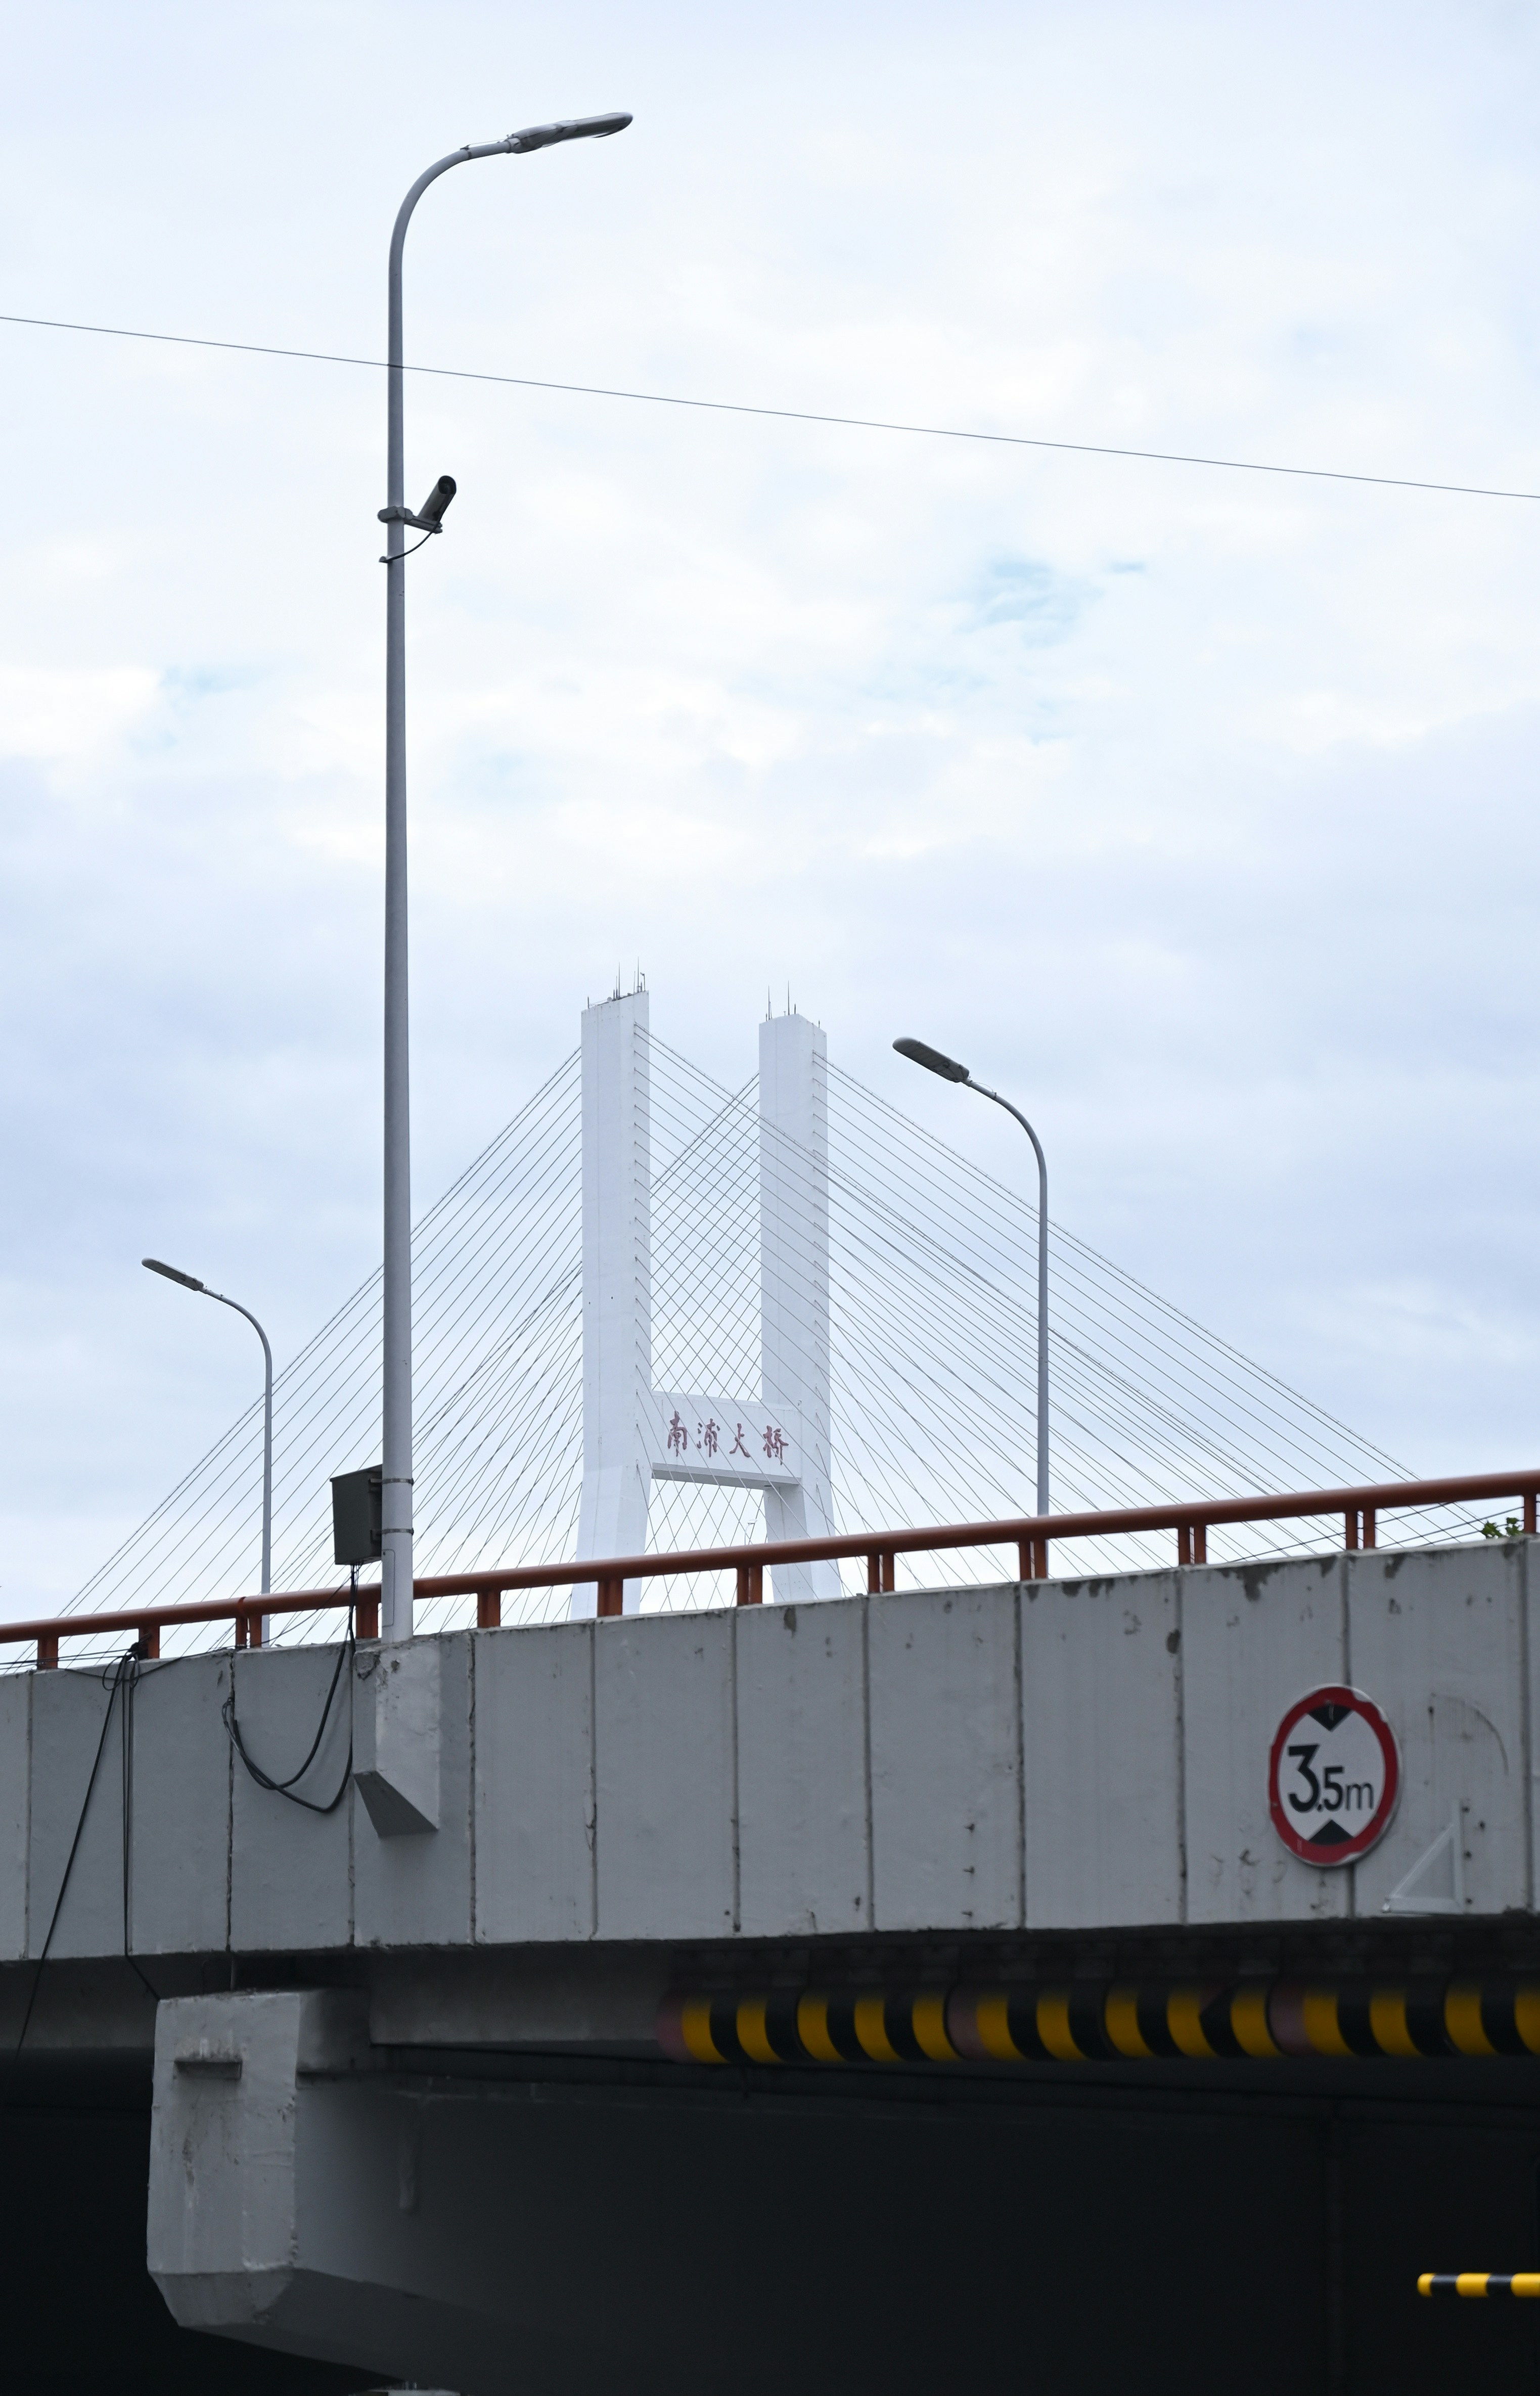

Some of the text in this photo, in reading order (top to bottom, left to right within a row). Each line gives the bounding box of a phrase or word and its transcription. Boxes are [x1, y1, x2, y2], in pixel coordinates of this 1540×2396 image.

[667, 1410, 789, 1465] 南浦大桥
[1288, 1744, 1374, 1813] 3.5m
